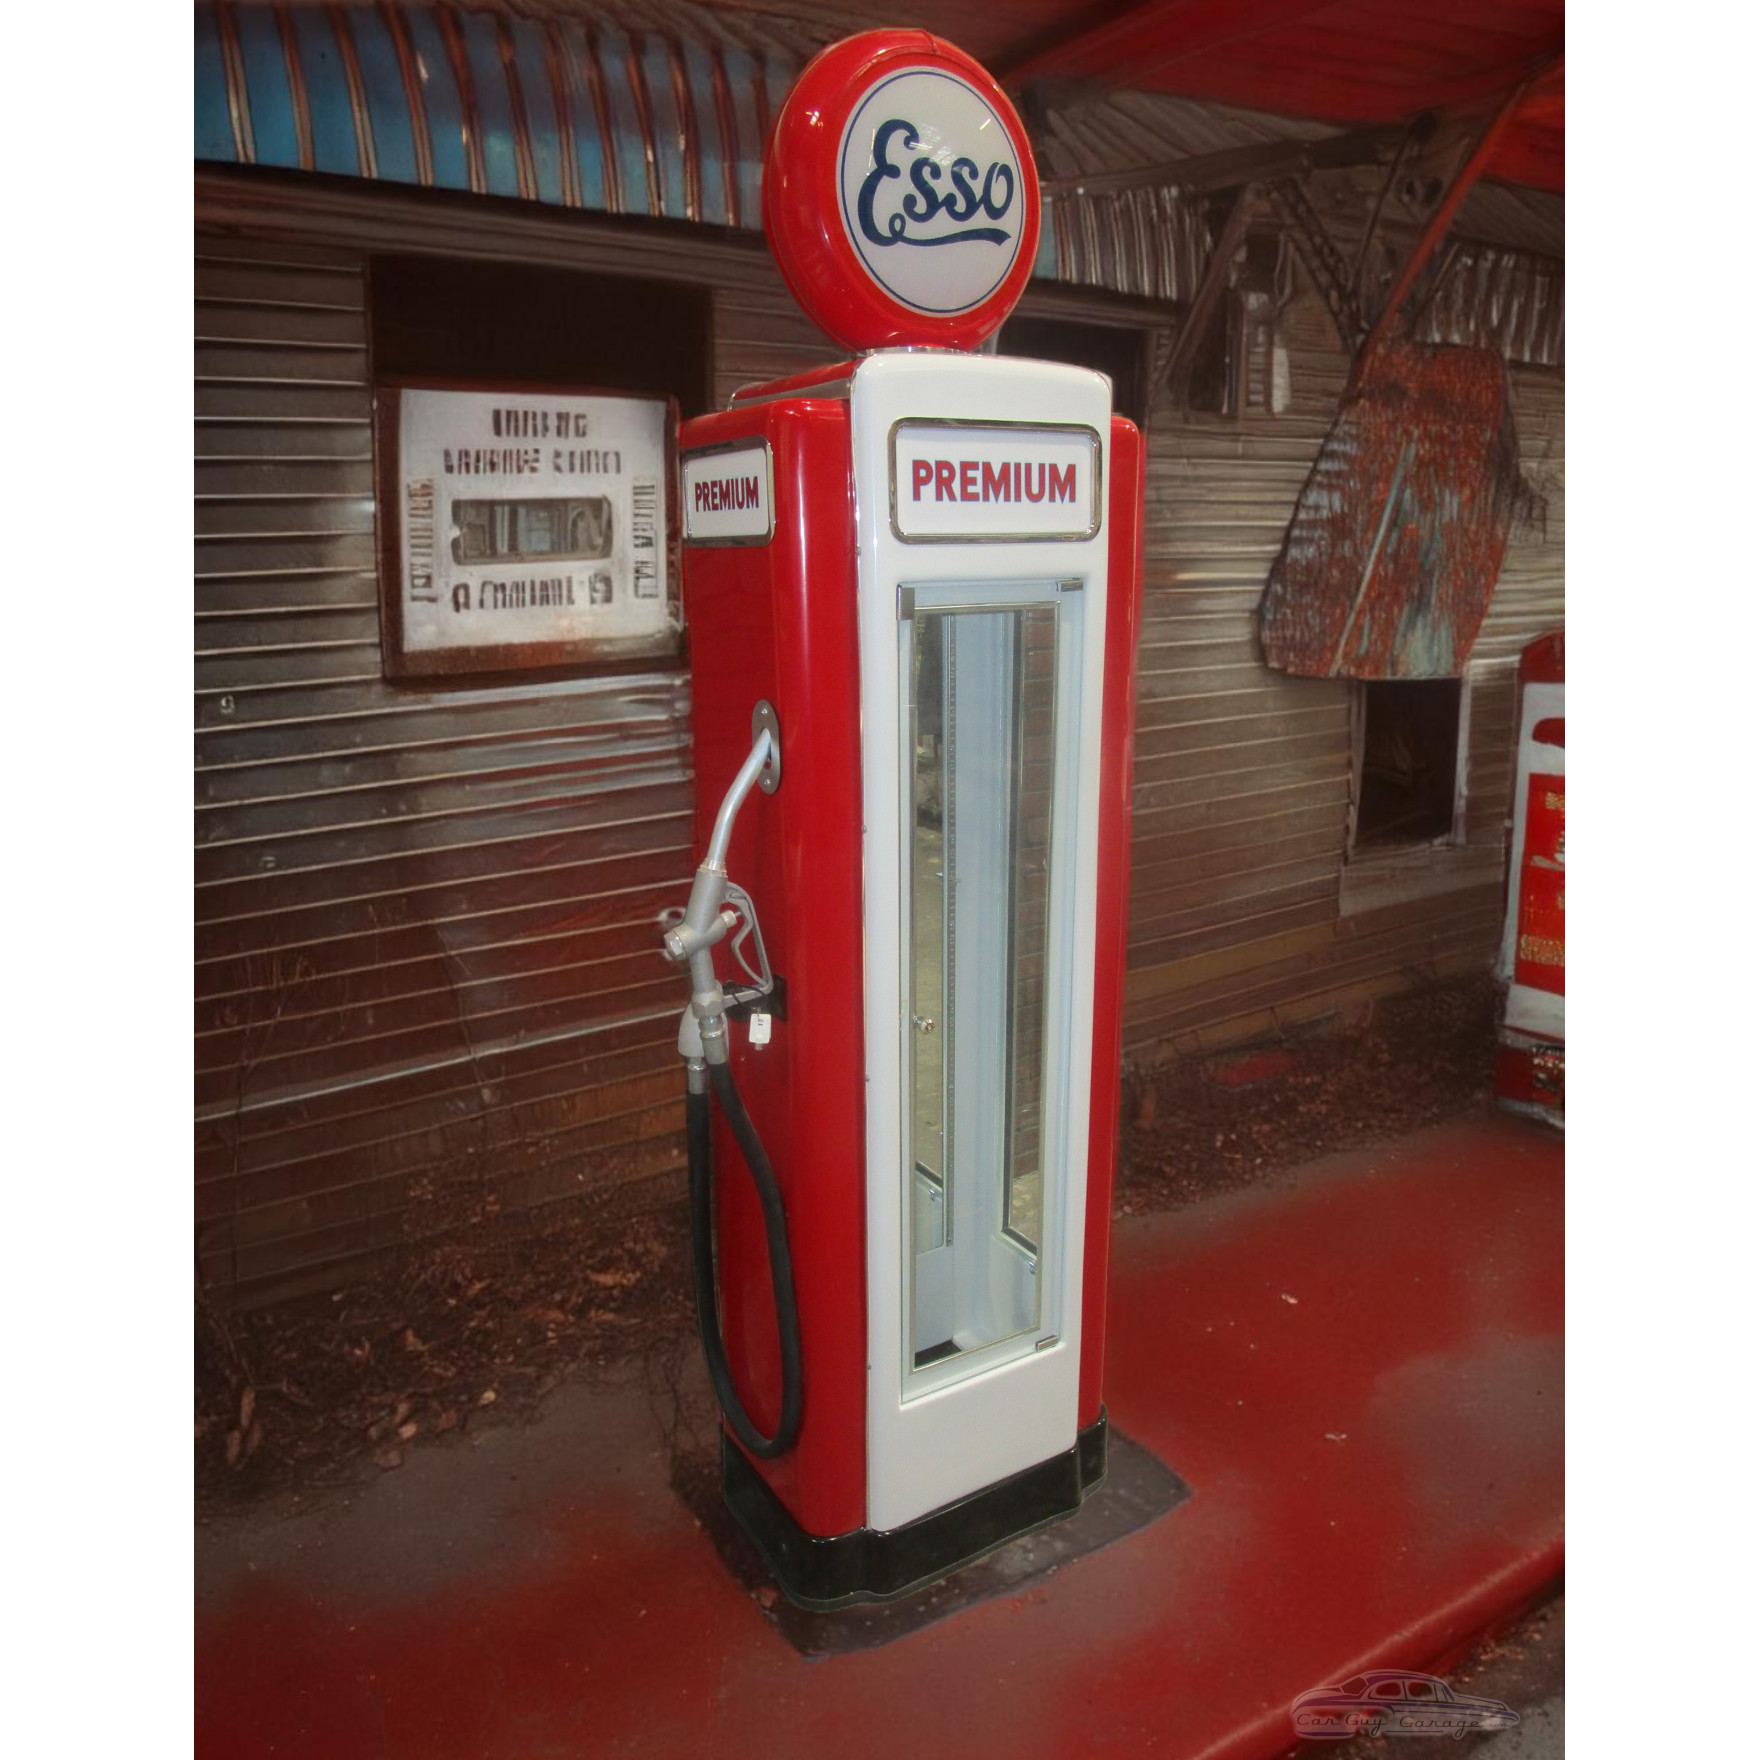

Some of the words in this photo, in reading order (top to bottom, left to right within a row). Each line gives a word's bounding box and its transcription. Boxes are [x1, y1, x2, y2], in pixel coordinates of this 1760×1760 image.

[858, 119, 1014, 246] Esso
[694, 476, 760, 513] PREMIUM
[912, 459, 1076, 504] PREMIUM
